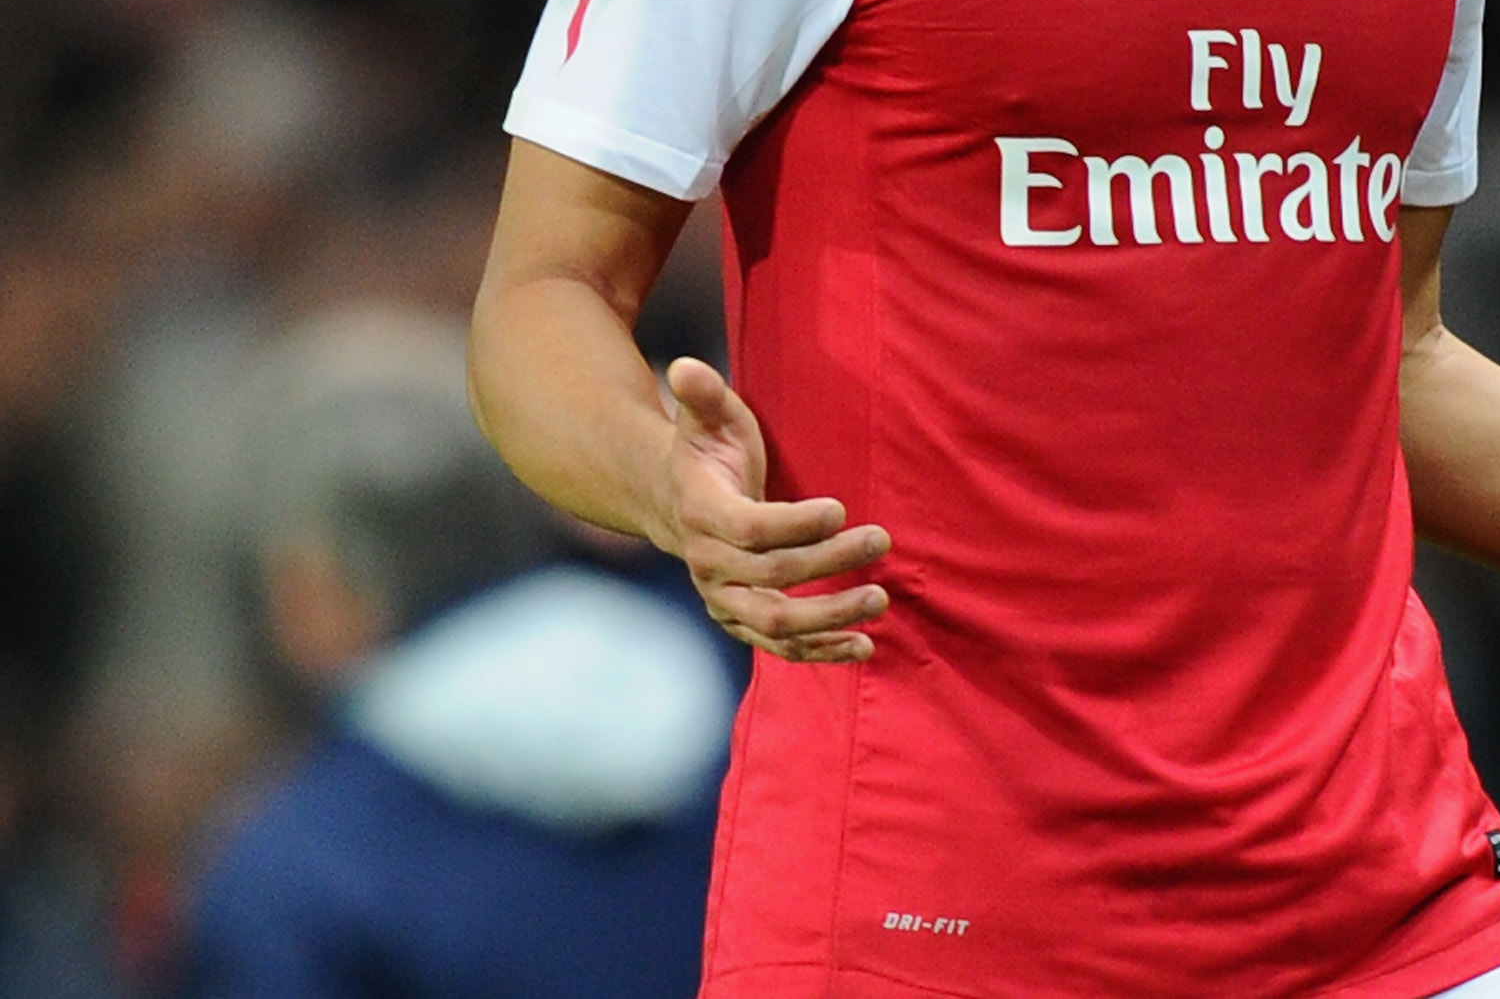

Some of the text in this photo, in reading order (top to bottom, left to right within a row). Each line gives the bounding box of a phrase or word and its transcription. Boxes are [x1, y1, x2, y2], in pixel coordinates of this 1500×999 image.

[1187, 28, 1322, 127] Fly
[994, 125, 1401, 247] Emirate
[882, 911, 970, 936] DRI-FIT
